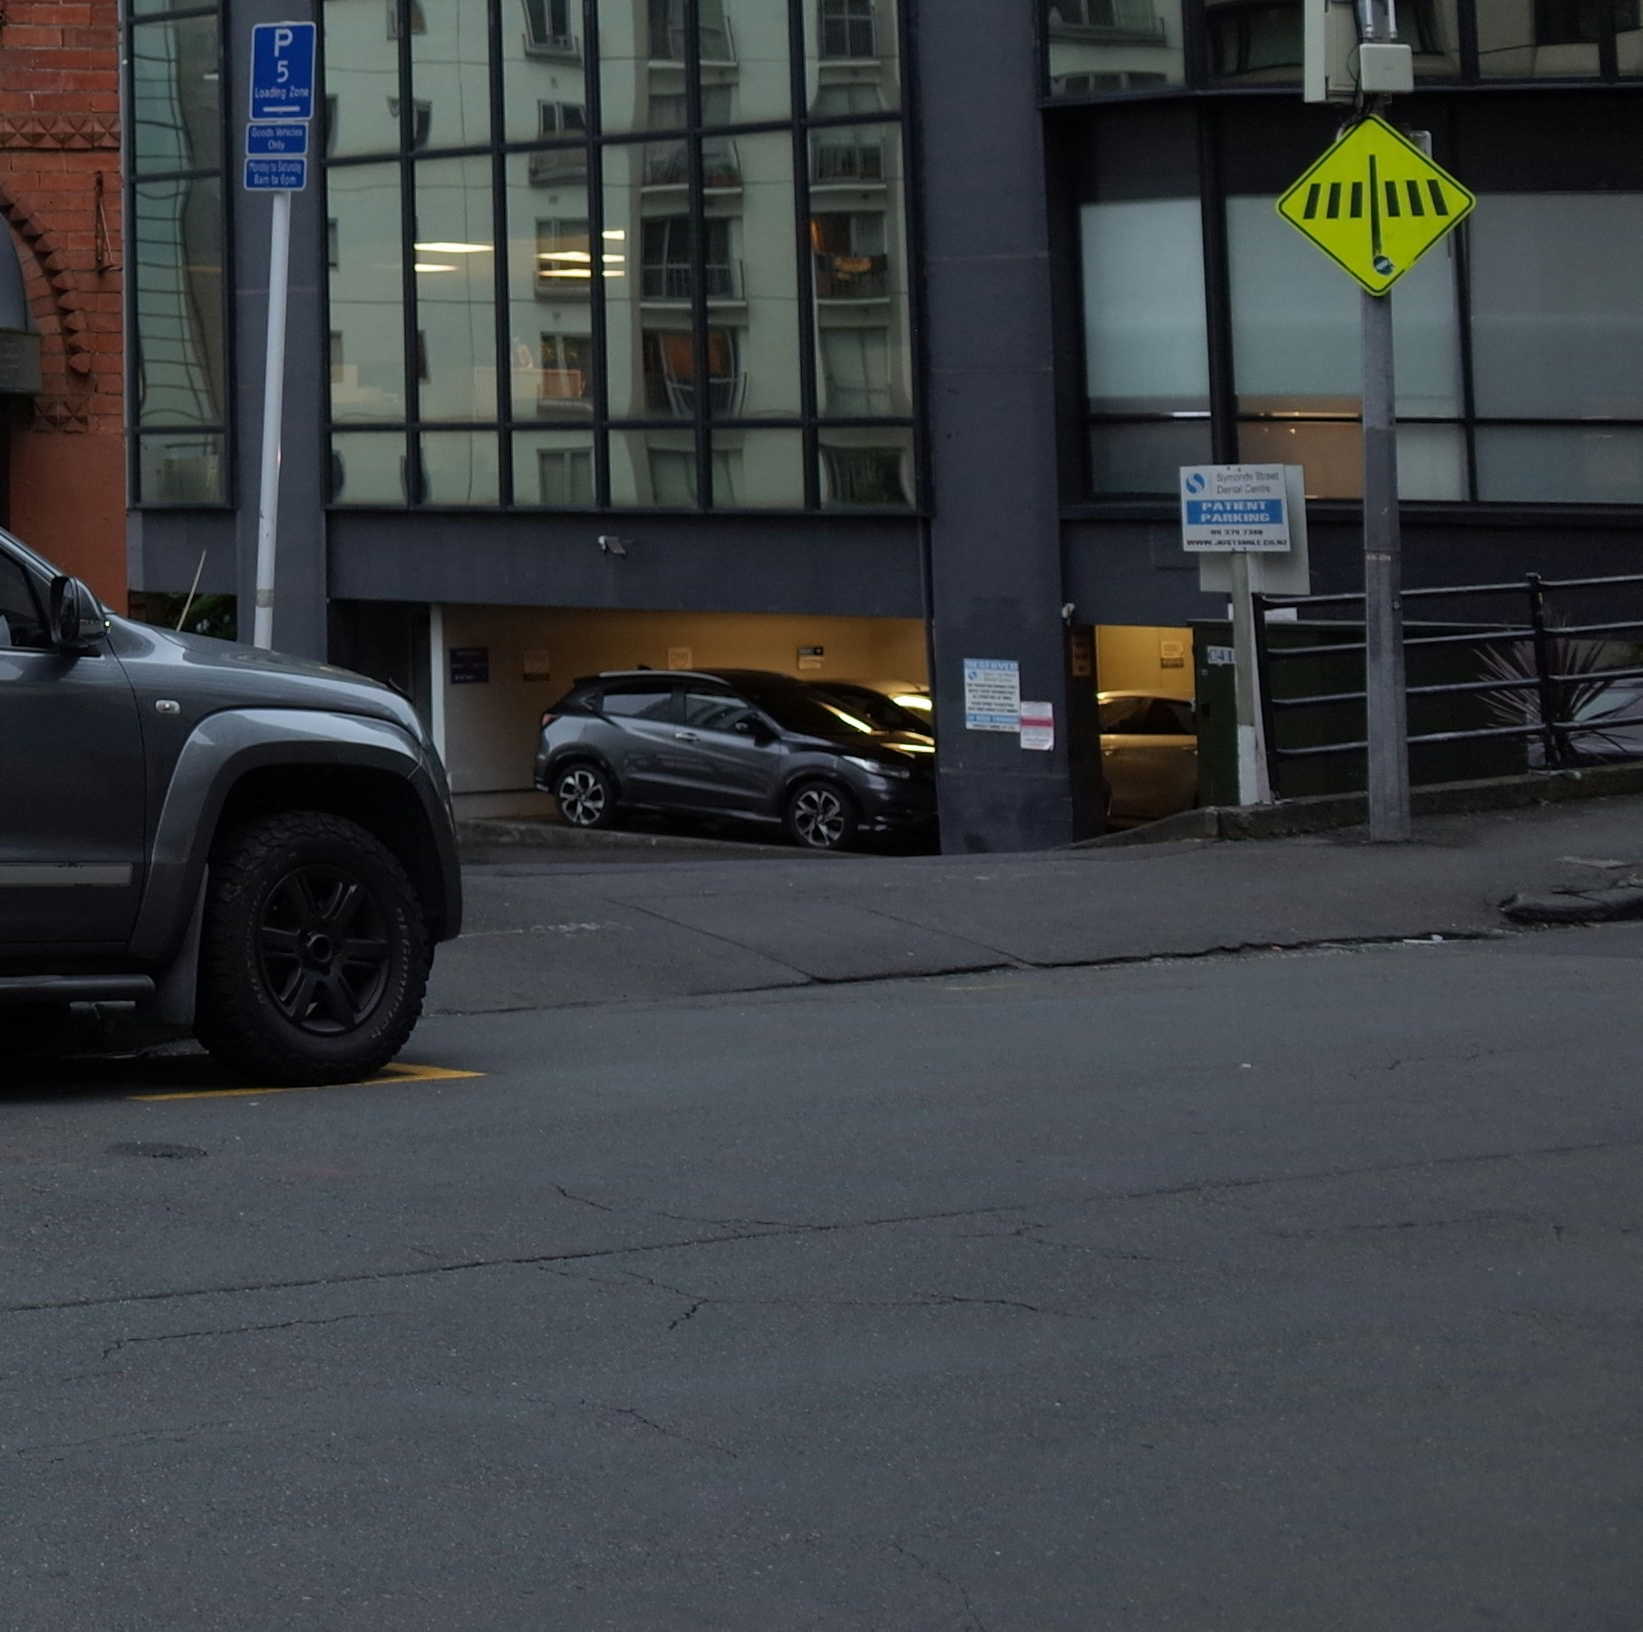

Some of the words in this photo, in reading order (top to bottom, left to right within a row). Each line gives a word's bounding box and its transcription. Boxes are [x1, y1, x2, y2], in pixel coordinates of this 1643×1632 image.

[274, 28, 293, 57] P
[276, 59, 289, 83] 5
[255, 85, 287, 100] Loading
[289, 85, 310, 98] Zone
[268, 139, 285, 151] Only
[1201, 501, 1268, 511] PATIENT
[1200, 512, 1271, 522] PARKING
